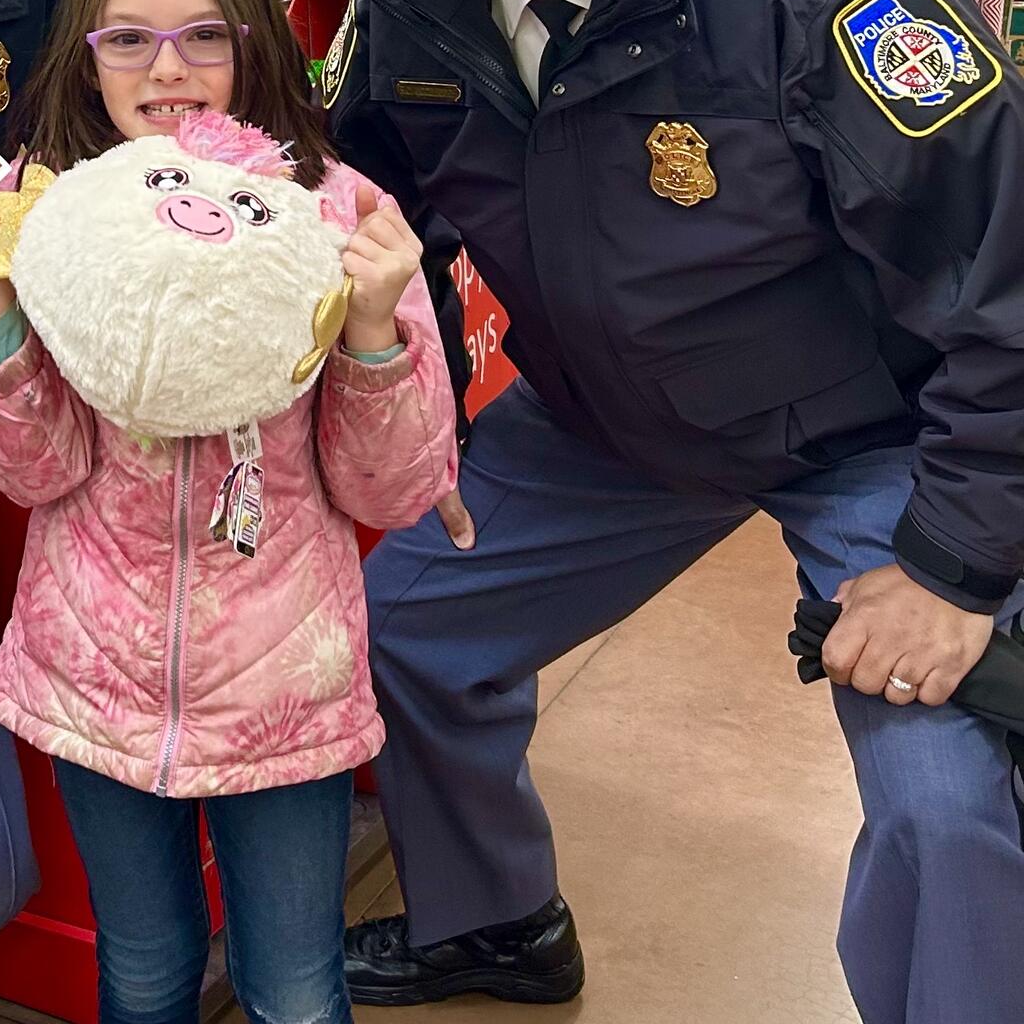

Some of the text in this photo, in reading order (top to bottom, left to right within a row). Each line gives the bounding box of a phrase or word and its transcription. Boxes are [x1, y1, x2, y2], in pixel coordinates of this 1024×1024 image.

[853, 7, 906, 47] POLICE
[881, 26, 943, 81] BALTIMORE COUNTY
[910, 62, 951, 95] MARYLAND
